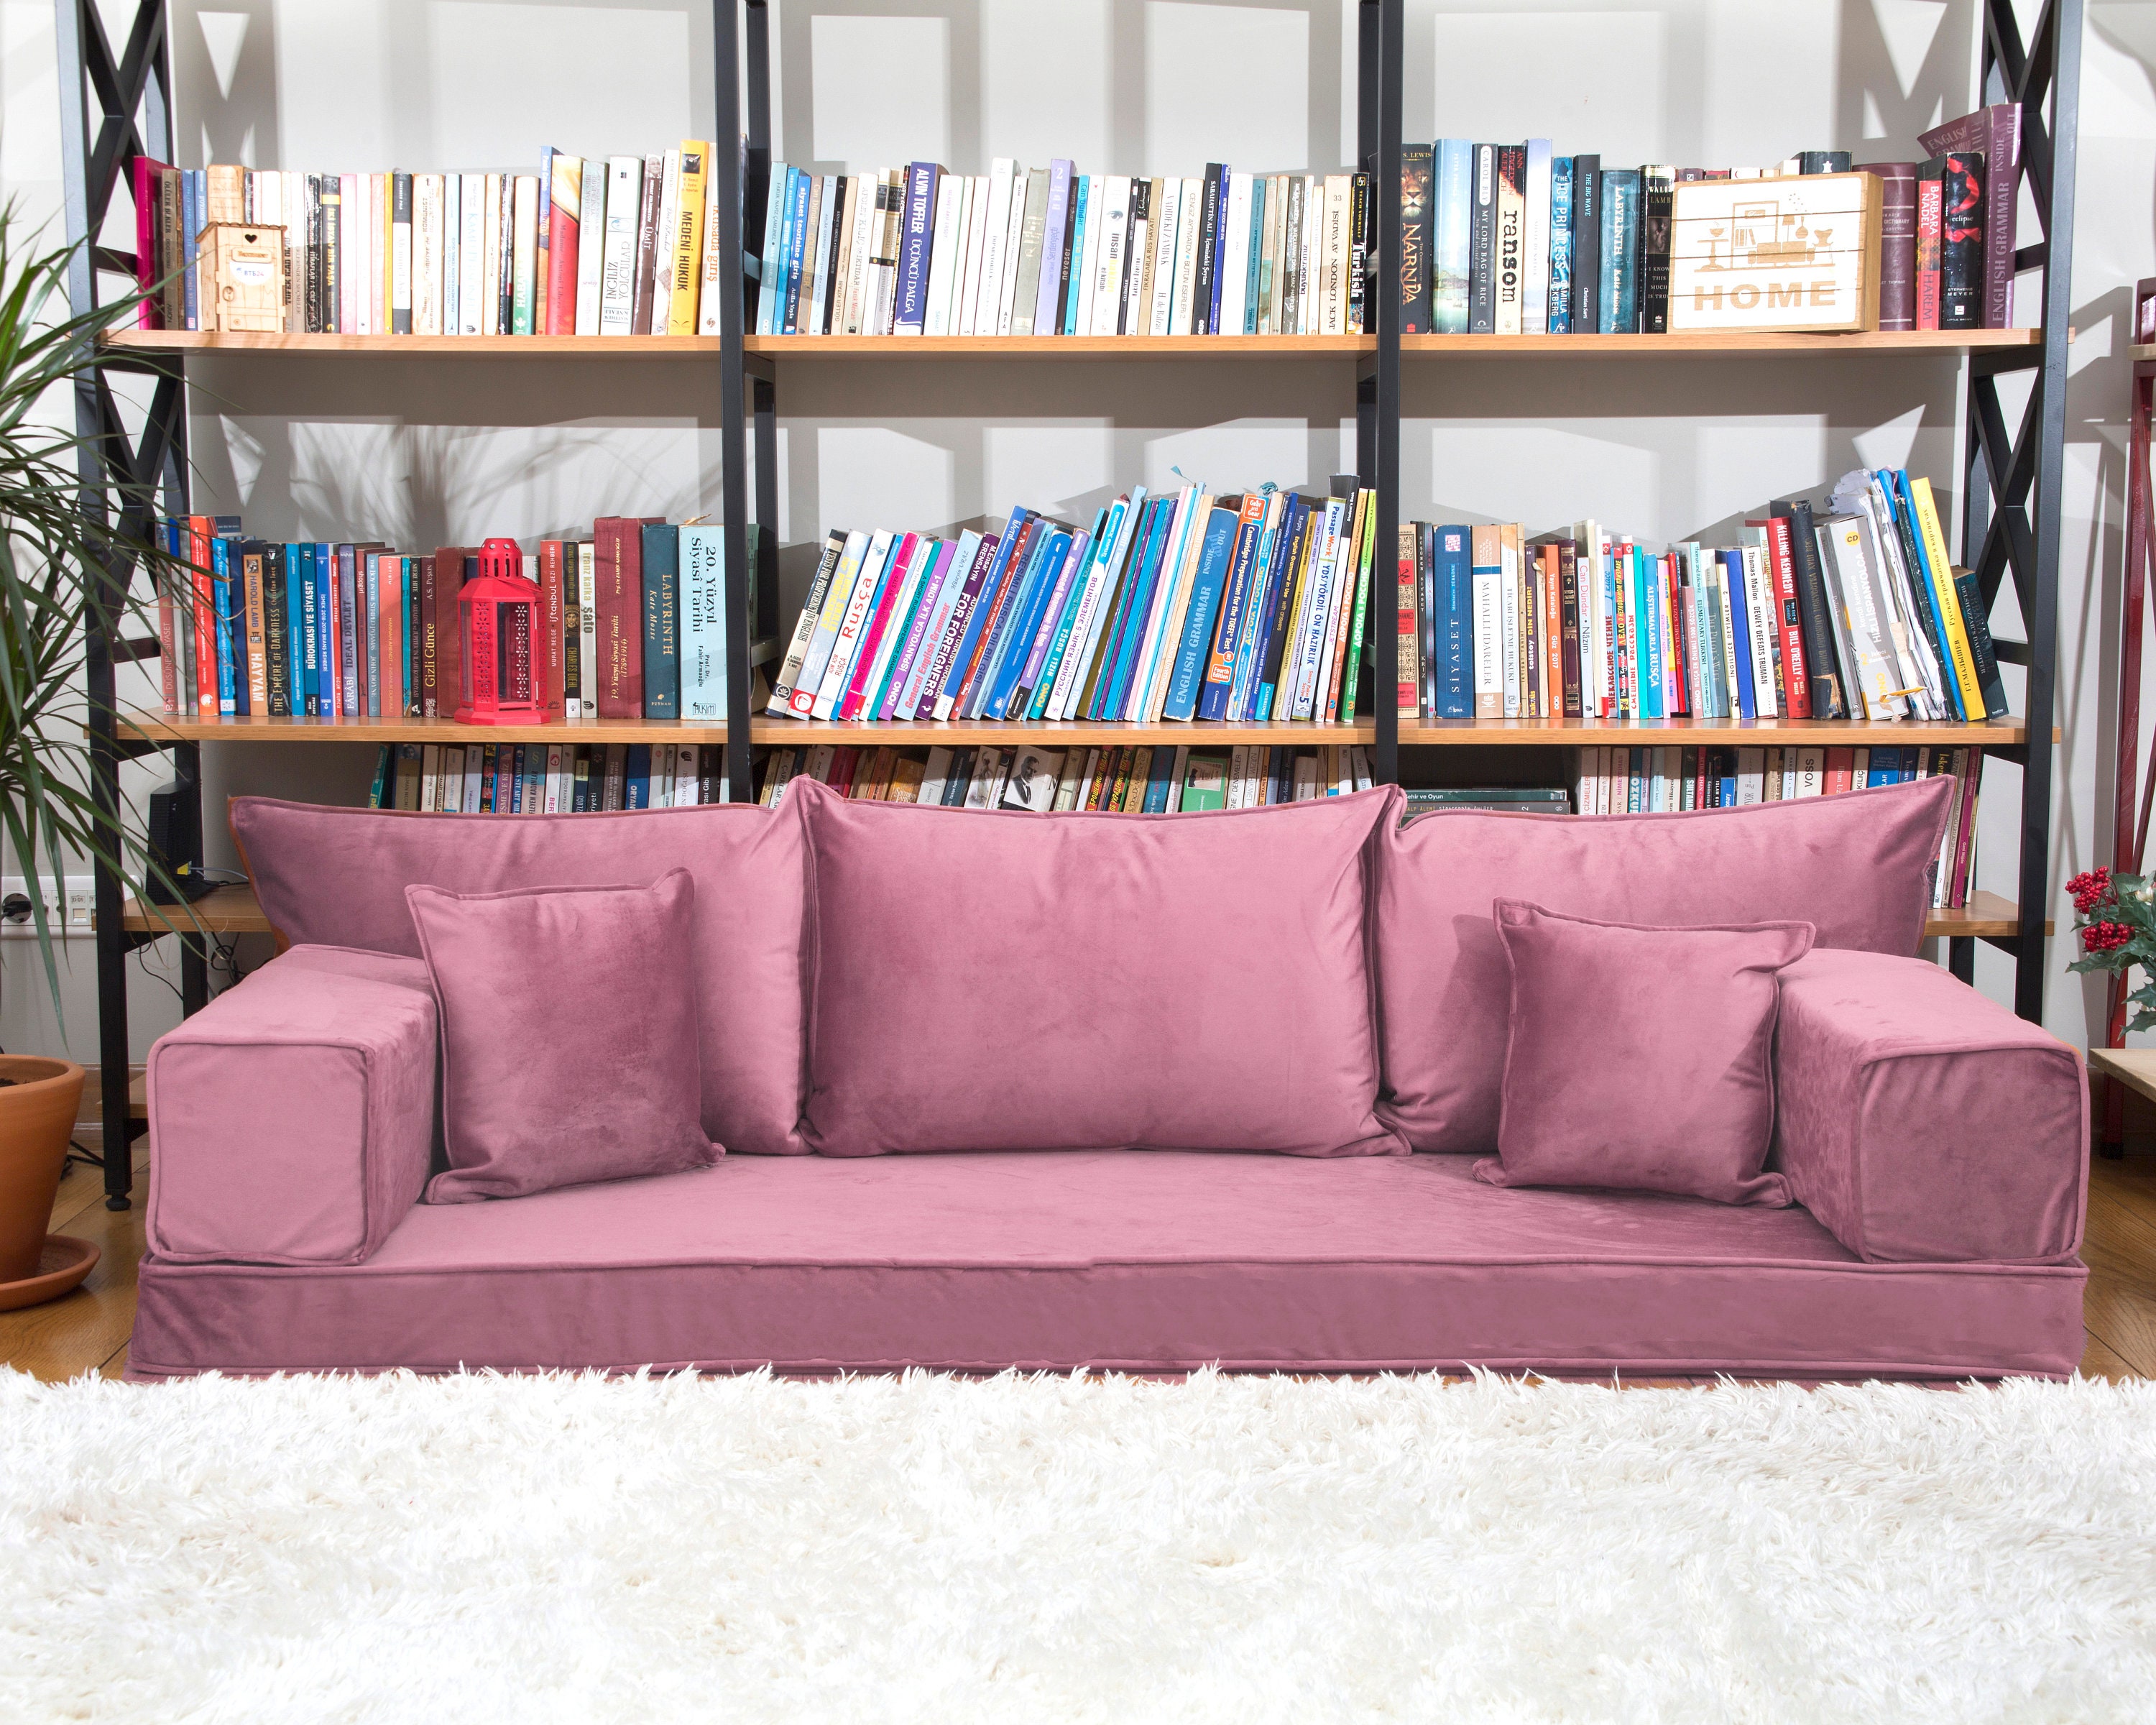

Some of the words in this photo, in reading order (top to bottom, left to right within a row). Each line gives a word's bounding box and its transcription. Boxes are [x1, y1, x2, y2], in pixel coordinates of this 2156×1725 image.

[915, 168, 929, 195] ALVIN
[798, 187, 807, 217] siyaset
[911, 197, 927, 234] TOFFLER
[1481, 211, 1488, 223] MY
[1930, 186, 1939, 234] BARBARA
[680, 211, 694, 251] MEDENİ
[1330, 211, 1339, 239] VADİSİ
[1614, 186, 1624, 256] LABYRINTH
[1995, 183, 2009, 255] GRAMMAR
[795, 219, 804, 258] teorisine
[1332, 240, 1338, 253] AY
[1556, 207, 1567, 270] PRINCESS
[619, 241, 631, 300] YOLCULAR
[677, 255, 690, 290] HUKUK
[791, 260, 801, 280] giriş
[907, 239, 922, 280] ÜÇÜNCÜ
[1350, 242, 1365, 298] Turkish
[1502, 210, 1518, 303] ransom
[326, 264, 335, 285] PAŞA
[605, 262, 618, 300] İNGİLİZ
[1480, 273, 1486, 283] OF
[1993, 259, 2007, 321] ENGLISH
[906, 281, 916, 313] DALGA
[1694, 280, 1836, 310] HOME
[1922, 275, 1933, 321] HAREM
[1295, 515, 1304, 532] Murphy
[1846, 535, 1859, 543] CD
[1241, 526, 1256, 560] Cambridge
[1289, 535, 1300, 555] English
[1776, 524, 1789, 556] KILLING
[583, 552, 591, 574] franz
[689, 537, 704, 582] Siyasî
[706, 546, 717, 571] 20.
[969, 542, 989, 581] ERENSAYIN
[982, 544, 996, 572] M.Ensar
[1285, 555, 1296, 581] Grammar
[1580, 565, 1588, 582] Can
[1748, 551, 1758, 576] Thomas
[584, 576, 593, 601] kafka
[1233, 560, 1249, 595] Preparation
[1358, 566, 1369, 604] РОССИЮ
[1751, 578, 1760, 601] Mallon
[1781, 557, 1794, 594] KENNEDY
[1932, 554, 1949, 596] грамматика
[303, 581, 313, 612] SİYASET
[691, 587, 704, 632] Tarihi
[704, 578, 717, 624] Yüzyıl
[841, 577, 872, 639] Rusça
[952, 592, 970, 617] FOR
[1230, 607, 1240, 617] the
[1233, 596, 1243, 606] for
[1581, 584, 1590, 617] Dündar
[1940, 597, 1955, 626] Русская
[305, 614, 315, 623] VE
[343, 600, 352, 637] DEVLET
[581, 607, 594, 633] şato
[662, 574, 673, 656] LABYRINTH
[1276, 611, 1285, 632] answers
[1314, 614, 1325, 627] ÖN
[1353, 612, 1365, 648] ДОРОГА
[1605, 615, 1614, 647] ЧТЕНИЕ
[1697, 599, 1705, 638] ELEMENTARY
[1753, 606, 1762, 628] DEWEY
[305, 625, 316, 669] BÜROKRASİ
[424, 623, 434, 658] Günce
[1054, 659, 1072, 696] РУССКИЙ
[1067, 631, 1080, 658] ЯЗЫК:
[1077, 576, 1097, 625] ЭЛЕМЕНТОВ
[1175, 651, 1197, 704] ENGLISH
[1189, 586, 1212, 648] GRAMMAR
[1223, 638, 1235, 650] Test
[1307, 628, 1322, 665] HAZIRLIK
[1582, 626, 1590, 653] Nâzım
[1756, 630, 1765, 656] DEFEATS
[1788, 631, 1799, 644] BILL
[344, 640, 354, 668] İDEAL
[905, 675, 923, 709] General
[916, 642, 936, 675] English
[928, 602, 950, 642] Grammar
[923, 620, 960, 696] FOREIGNERS
[1450, 619, 1459, 693] SİYASET
[1759, 656, 1768, 684] TRUMAN
[1790, 645, 1802, 676] O'REILLY
[251, 653, 264, 702] HAYYAM
[424, 661, 436, 687] Gizli
[1606, 650, 1616, 708] ВНЕКЛАССНОЕ
[886, 681, 903, 707] FONO
[1233, 754, 1242, 793] DENEMELER
[1805, 758, 1815, 788] VOSS
